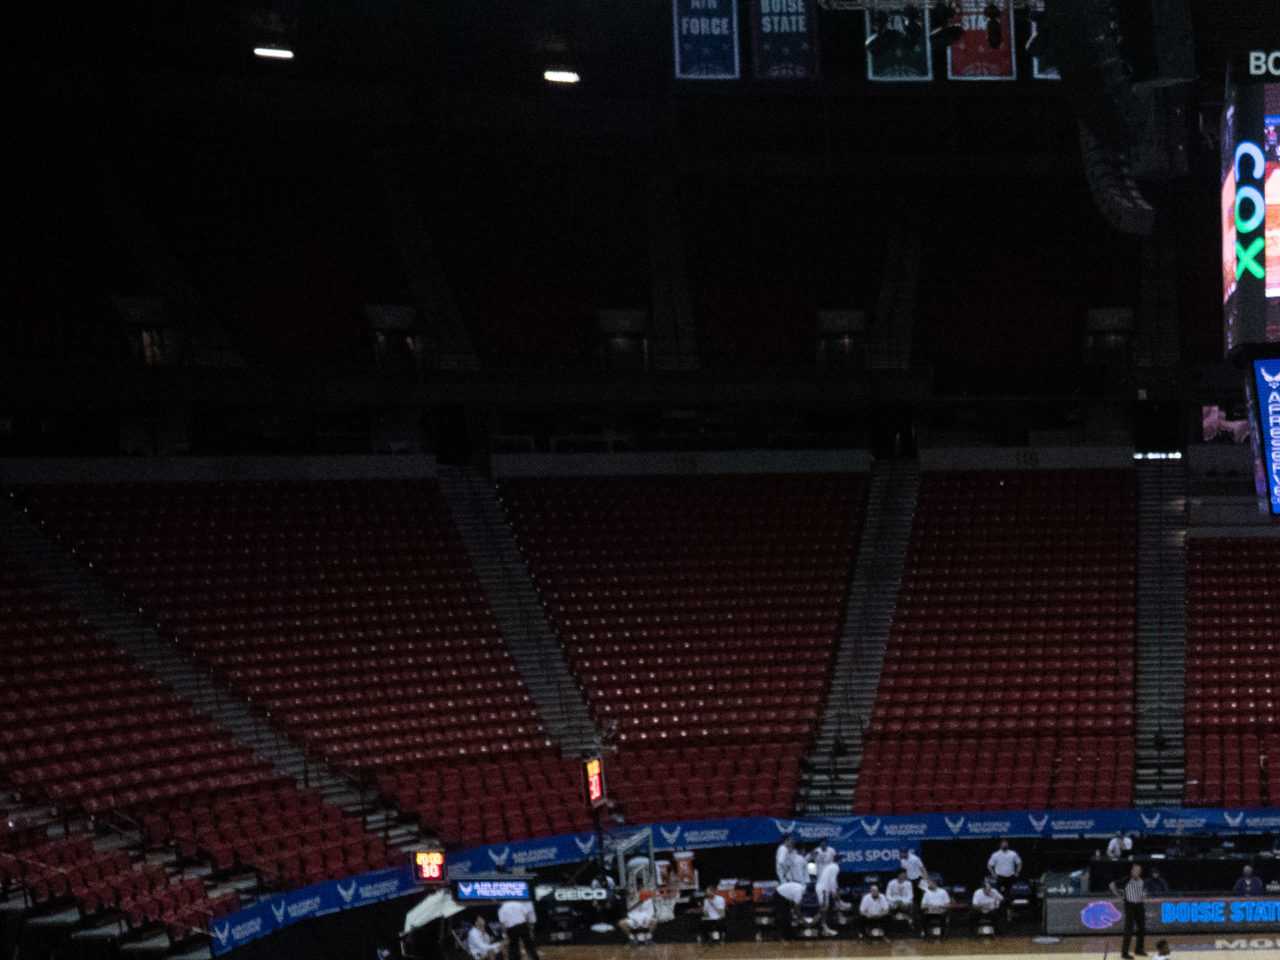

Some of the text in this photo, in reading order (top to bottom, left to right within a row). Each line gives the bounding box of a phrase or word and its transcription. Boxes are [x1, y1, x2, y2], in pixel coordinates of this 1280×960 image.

[681, 17, 729, 36] FORCE
[761, 16, 808, 33] STATE
[1234, 141, 1266, 281] COX
[554, 887, 607, 901] GEICO
[1161, 901, 1225, 924] BOISE
